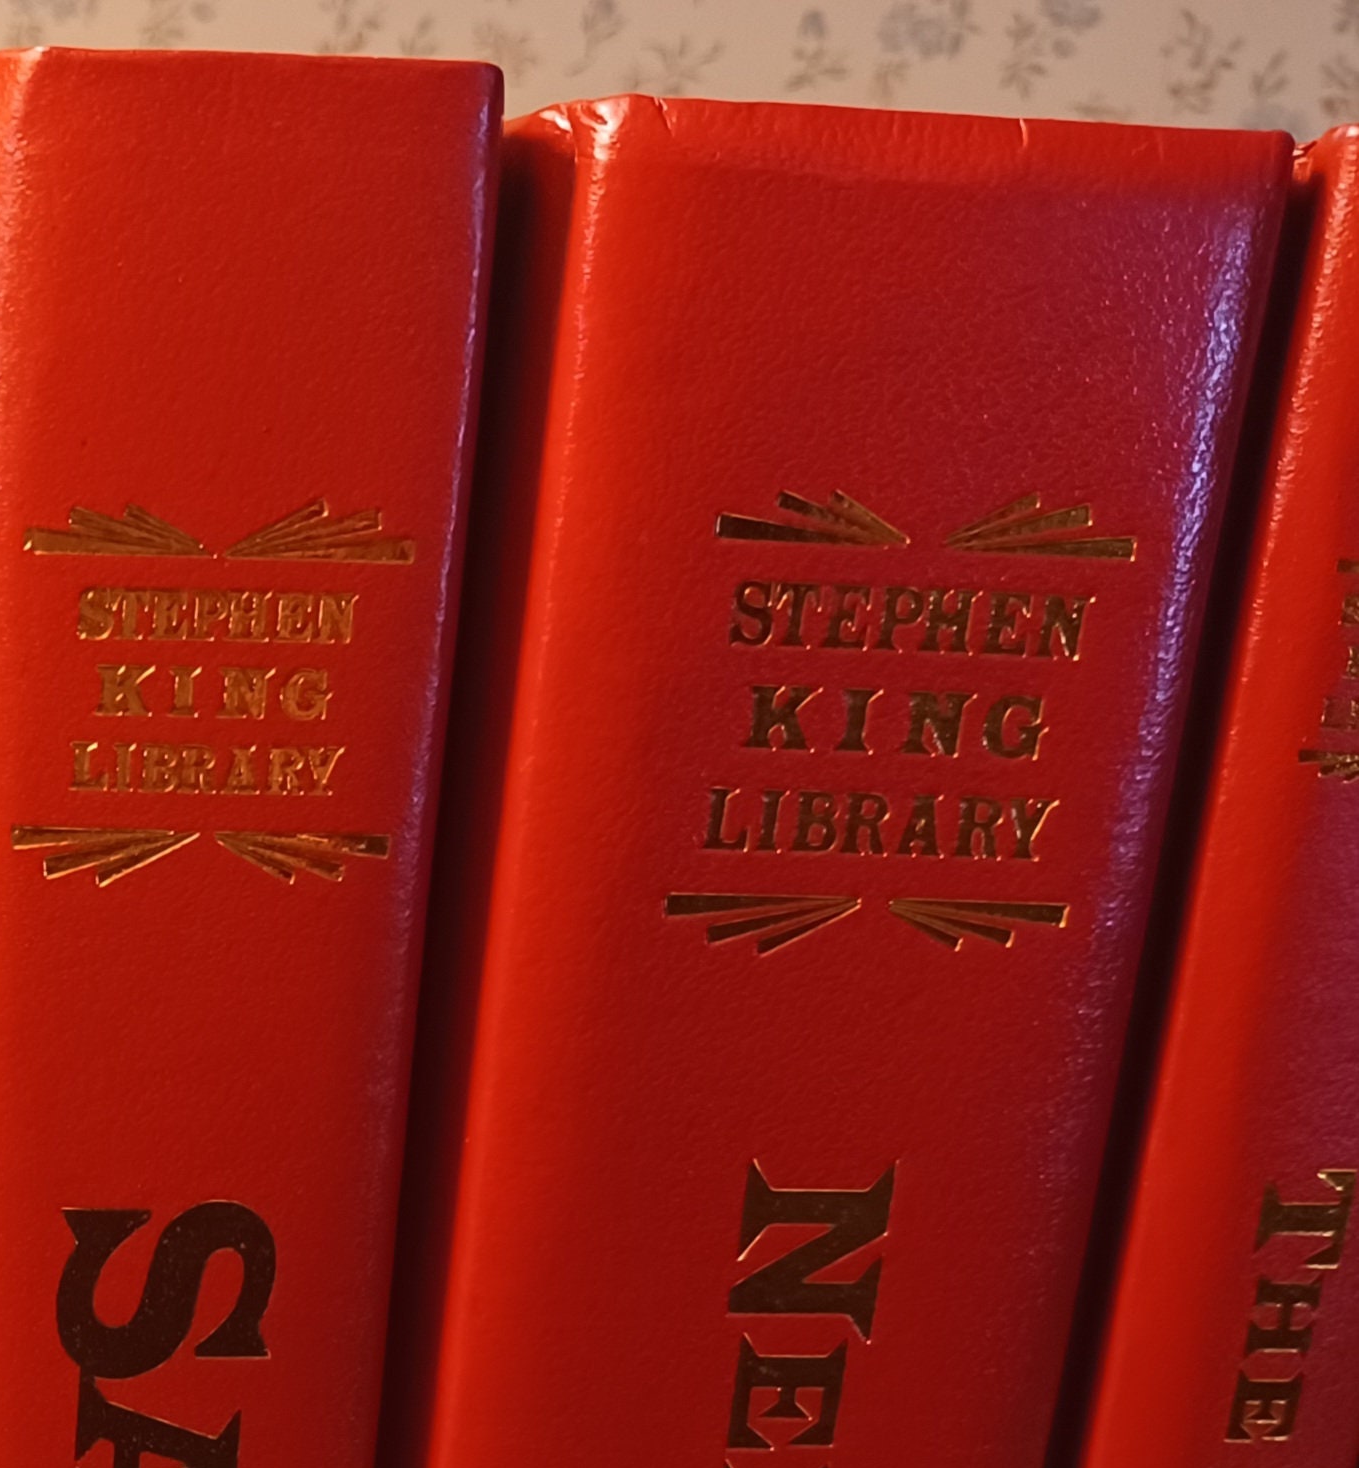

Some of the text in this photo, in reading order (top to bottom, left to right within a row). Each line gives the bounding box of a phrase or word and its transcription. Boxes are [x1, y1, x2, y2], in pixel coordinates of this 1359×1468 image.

[76, 587, 359, 643] STEPHEN
[728, 579, 1097, 662] STEPHEN
[94, 664, 334, 720] KING
[742, 683, 1050, 761] KING
[68, 741, 346, 796] LIBRARY
[702, 786, 1060, 863] LIBRARY
[1223, 1168, 1357, 1444] THE
